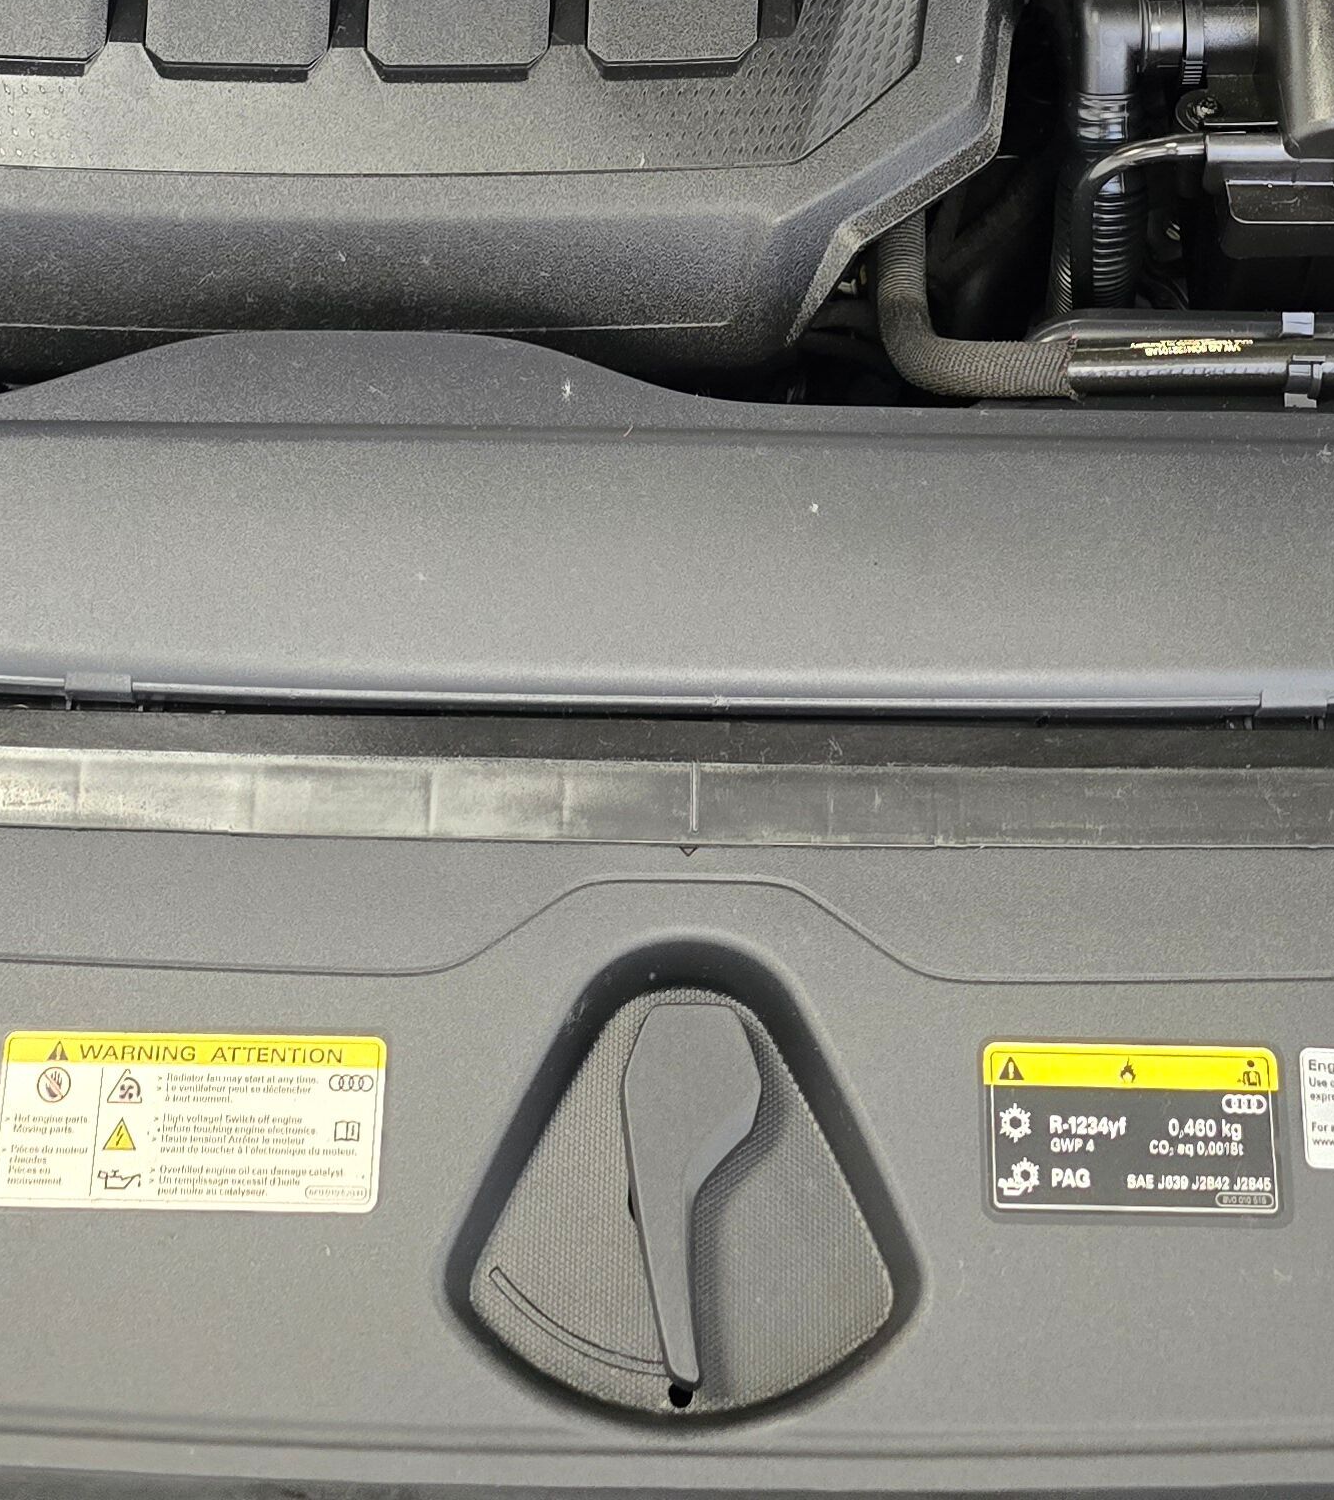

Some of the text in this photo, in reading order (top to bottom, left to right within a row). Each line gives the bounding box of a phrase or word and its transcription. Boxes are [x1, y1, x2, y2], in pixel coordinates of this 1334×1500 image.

[80, 1044, 343, 1064] WARNING ATTENTION
[223, 1076, 242, 1084] may
[277, 1077, 294, 1085] any
[1308, 1076, 1327, 1087] Use
[1049, 1115, 1127, 1140] R-1234yf
[1221, 1118, 1242, 1141] kg
[1311, 1122, 1327, 1132] For
[1050, 1137, 1095, 1153] GWP 4
[1051, 1168, 1091, 1188] PAG
[1126, 1173, 1155, 1189] SAE
